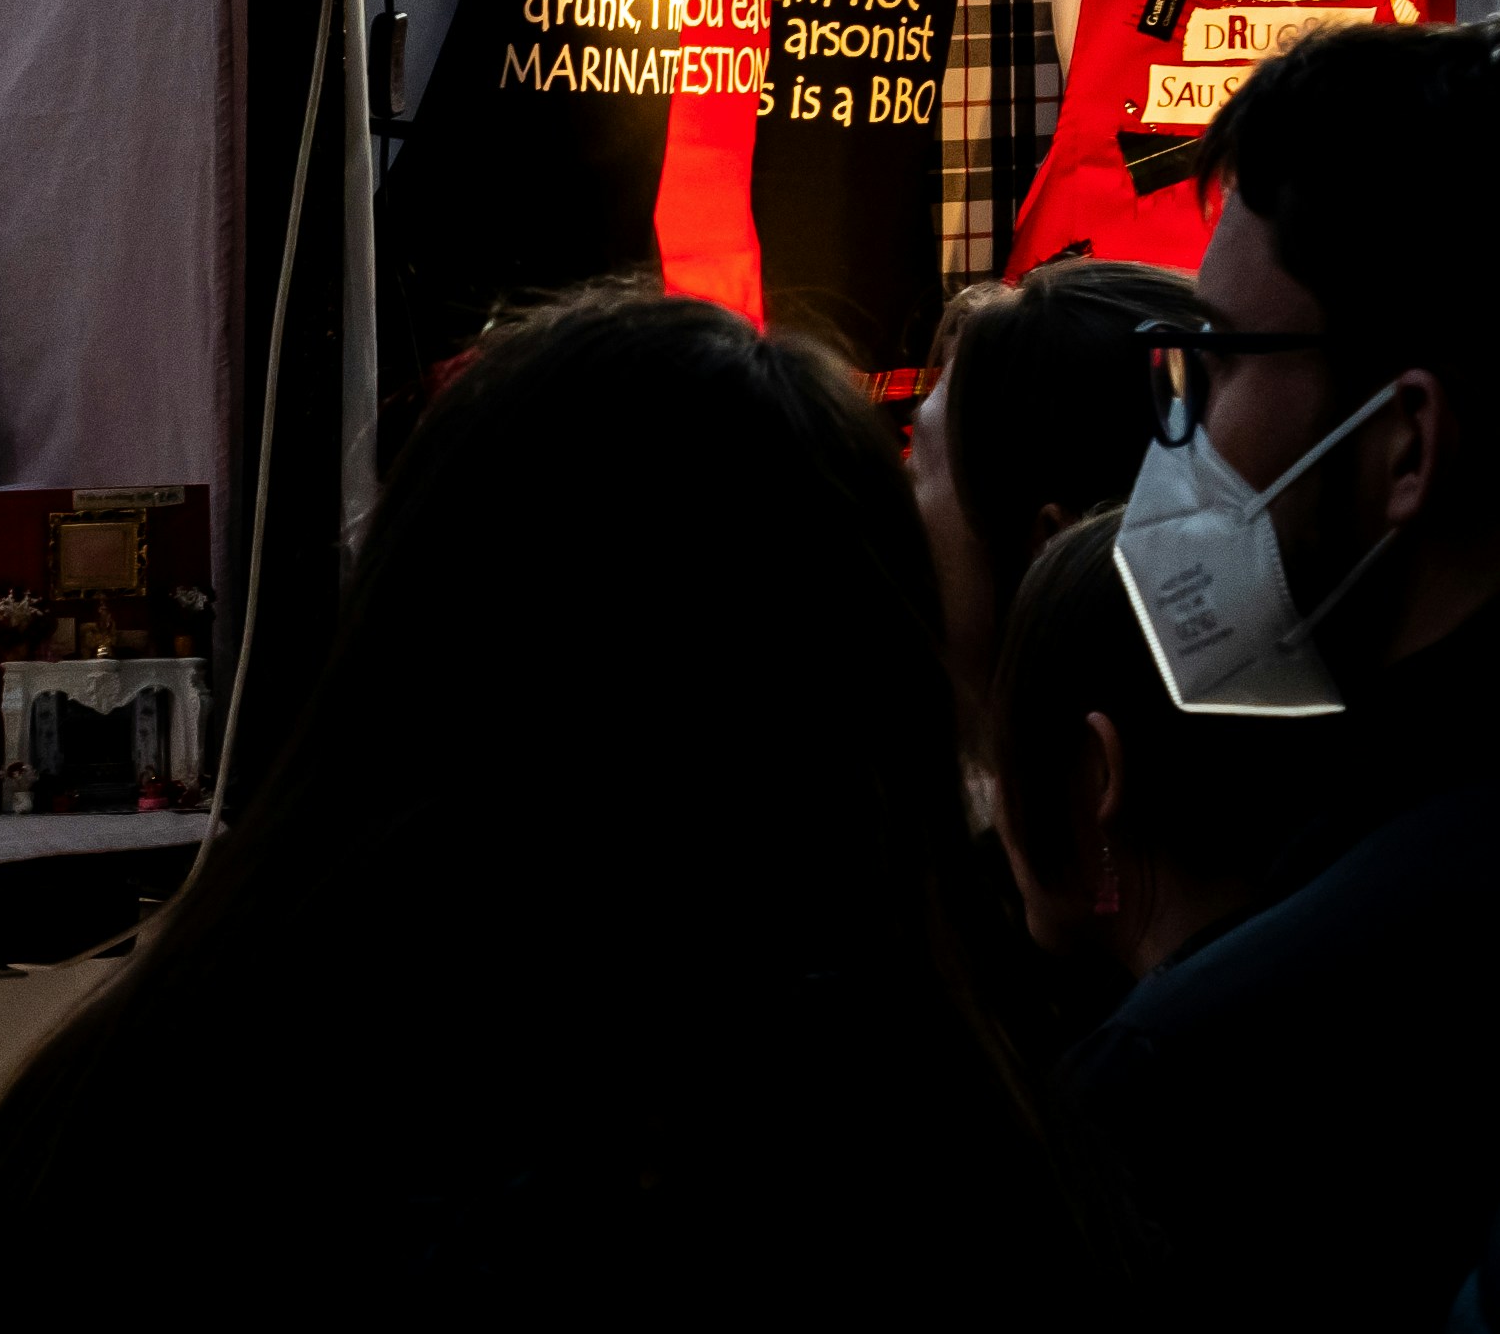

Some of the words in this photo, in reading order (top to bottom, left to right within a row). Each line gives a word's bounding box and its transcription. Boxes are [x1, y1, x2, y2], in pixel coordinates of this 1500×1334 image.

[784, 15, 934, 63] arsonist
[791, 75, 821, 119] is
[832, 86, 853, 127] a
[869, 76, 935, 124] BBQ
